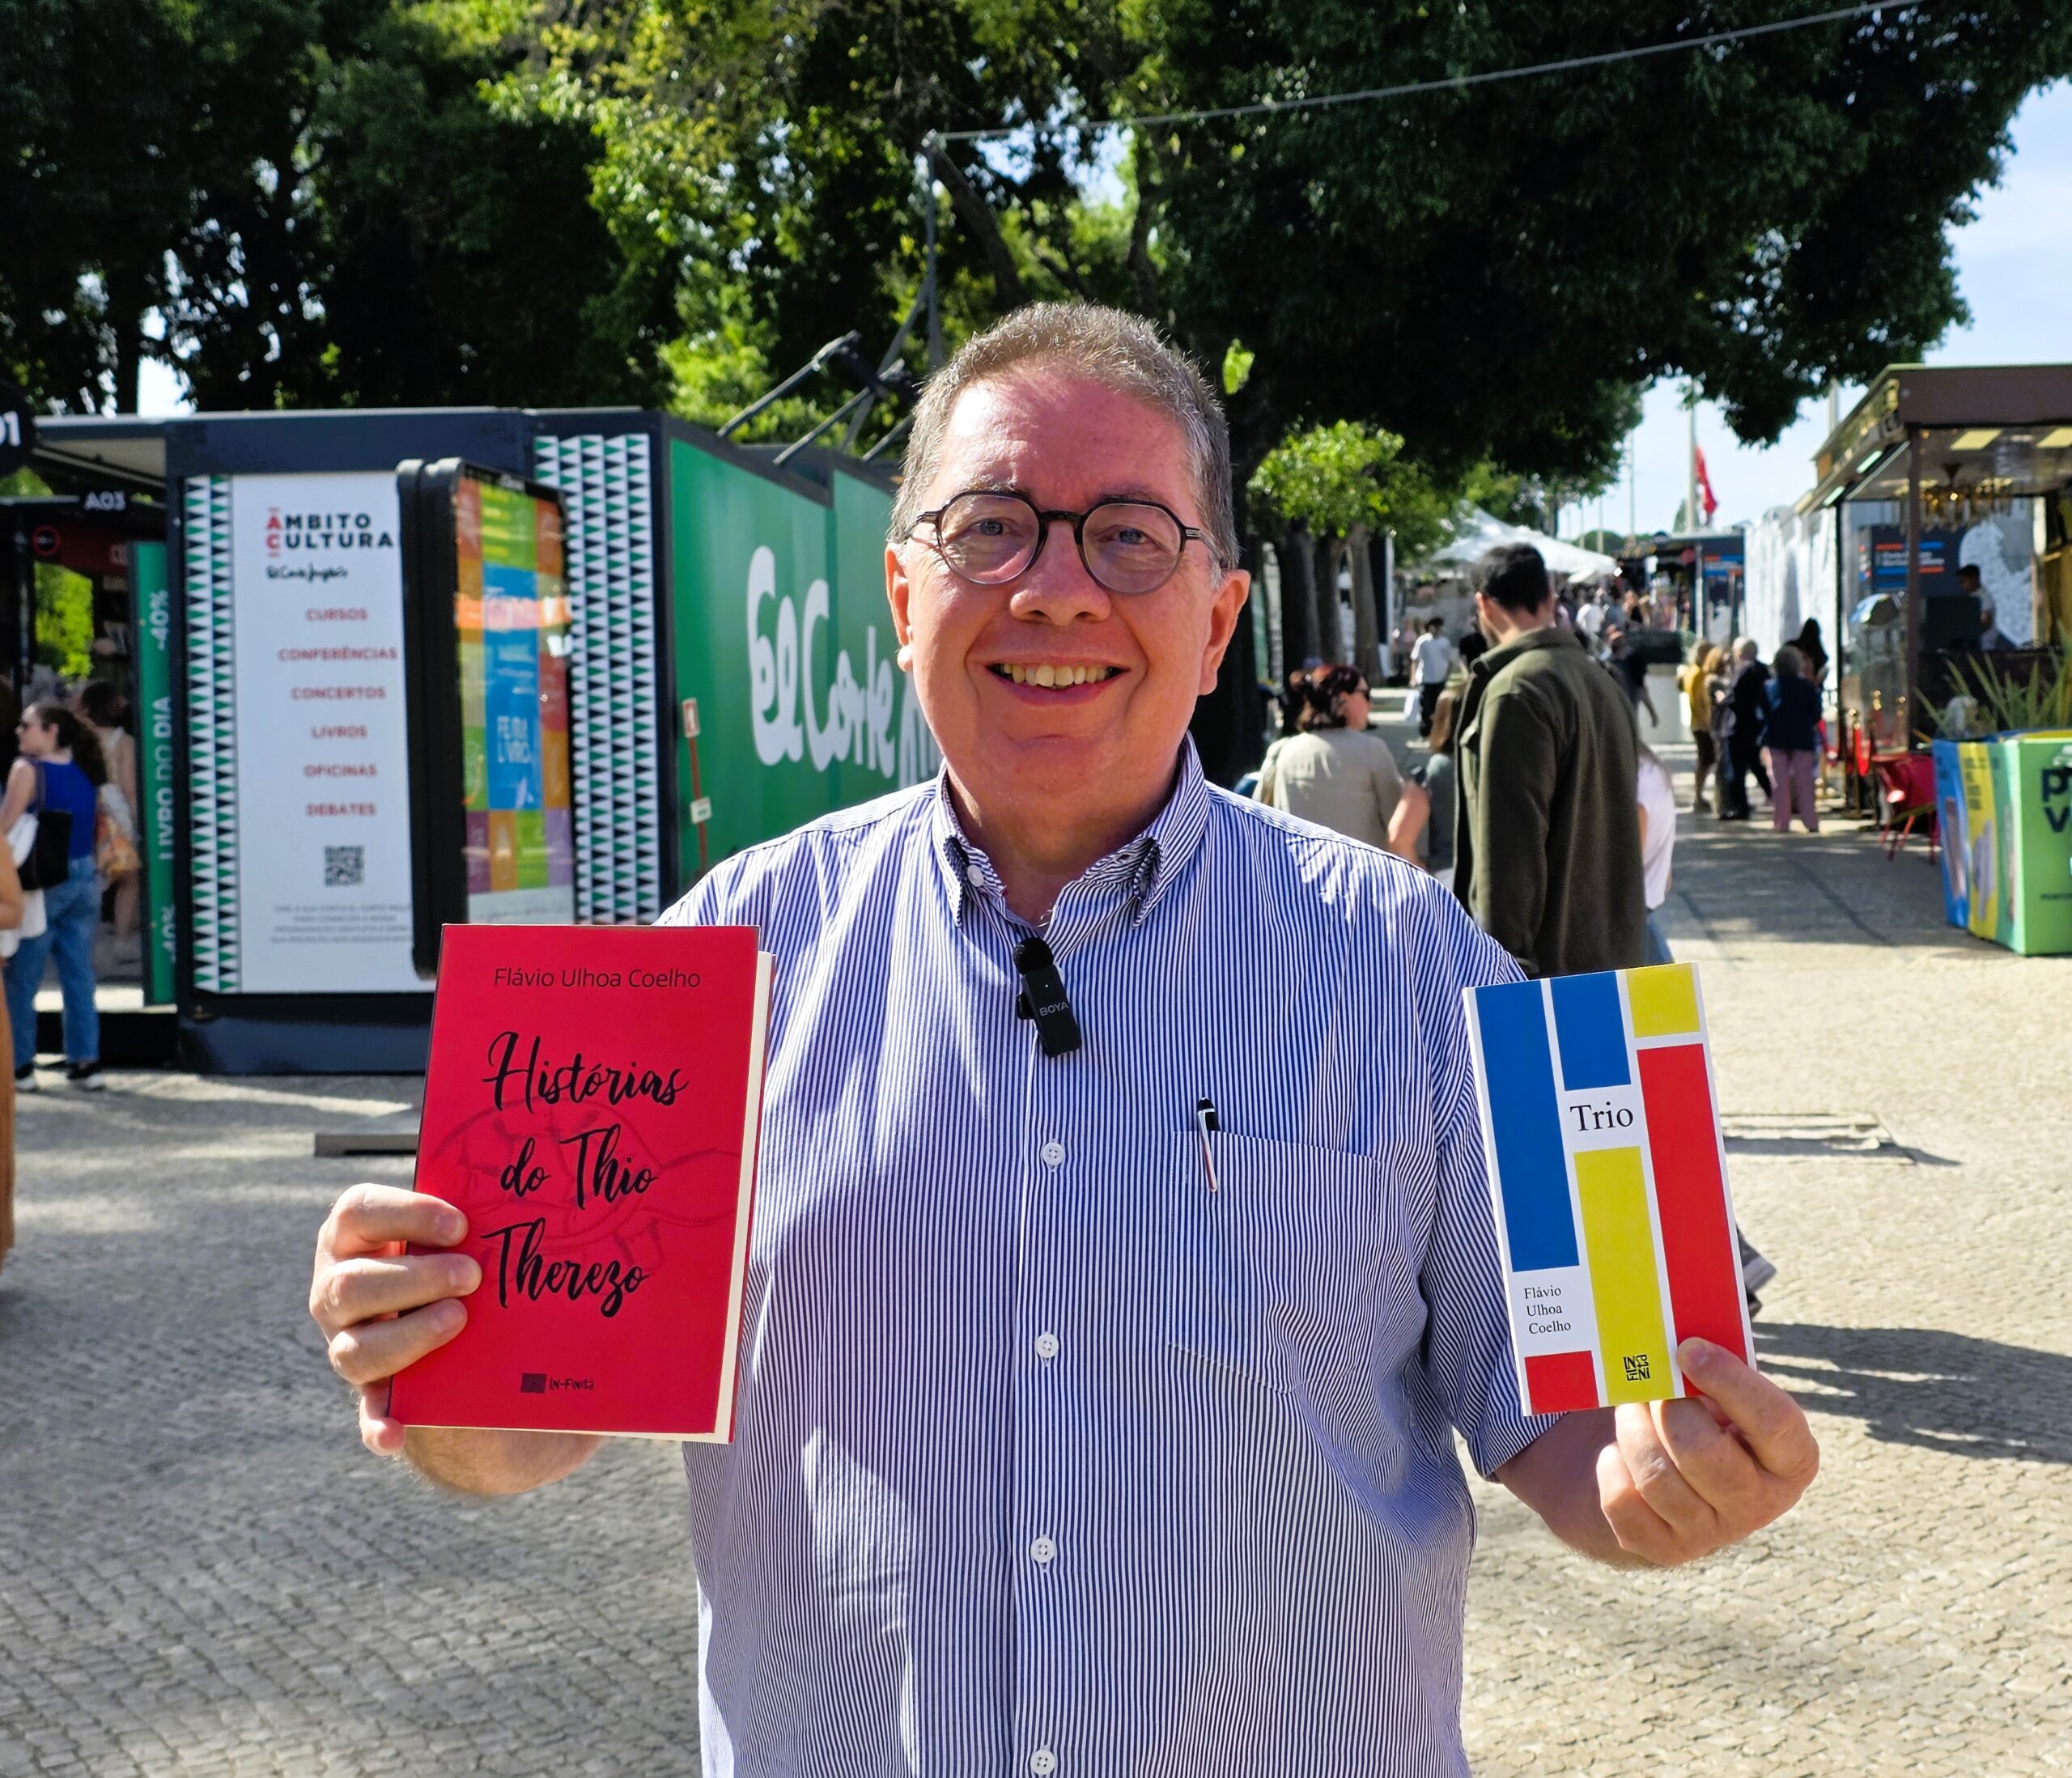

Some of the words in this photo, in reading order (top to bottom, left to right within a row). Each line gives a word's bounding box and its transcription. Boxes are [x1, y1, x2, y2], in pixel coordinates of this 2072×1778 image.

[0, 411, 21, 446] 1
[266, 533, 394, 550] CULTURA
[305, 609, 367, 621] CURSOS
[278, 646, 397, 661] CONFERÊNCIAS
[291, 687, 386, 700] CONCERTOS
[152, 696, 172, 739] DIA
[312, 726, 367, 738] LIVROS
[304, 765, 377, 778] OFICINAS
[305, 804, 376, 816] DEBATES
[494, 967, 554, 987] Flávio
[562, 969, 621, 987] Ulhoa
[628, 970, 701, 988] Coelho
[1039, 1002, 1069, 1016] BOYA
[482, 1031, 689, 1114] Histórias
[1570, 1101, 1633, 1131] Trio
[500, 1137, 551, 1197] do
[558, 1123, 659, 1210] Thio
[480, 1217, 650, 1318] Therezo
[1524, 1285, 1561, 1299] Flávio
[1526, 1304, 1563, 1317] Ulhoa
[1528, 1321, 1571, 1335] Coelho
